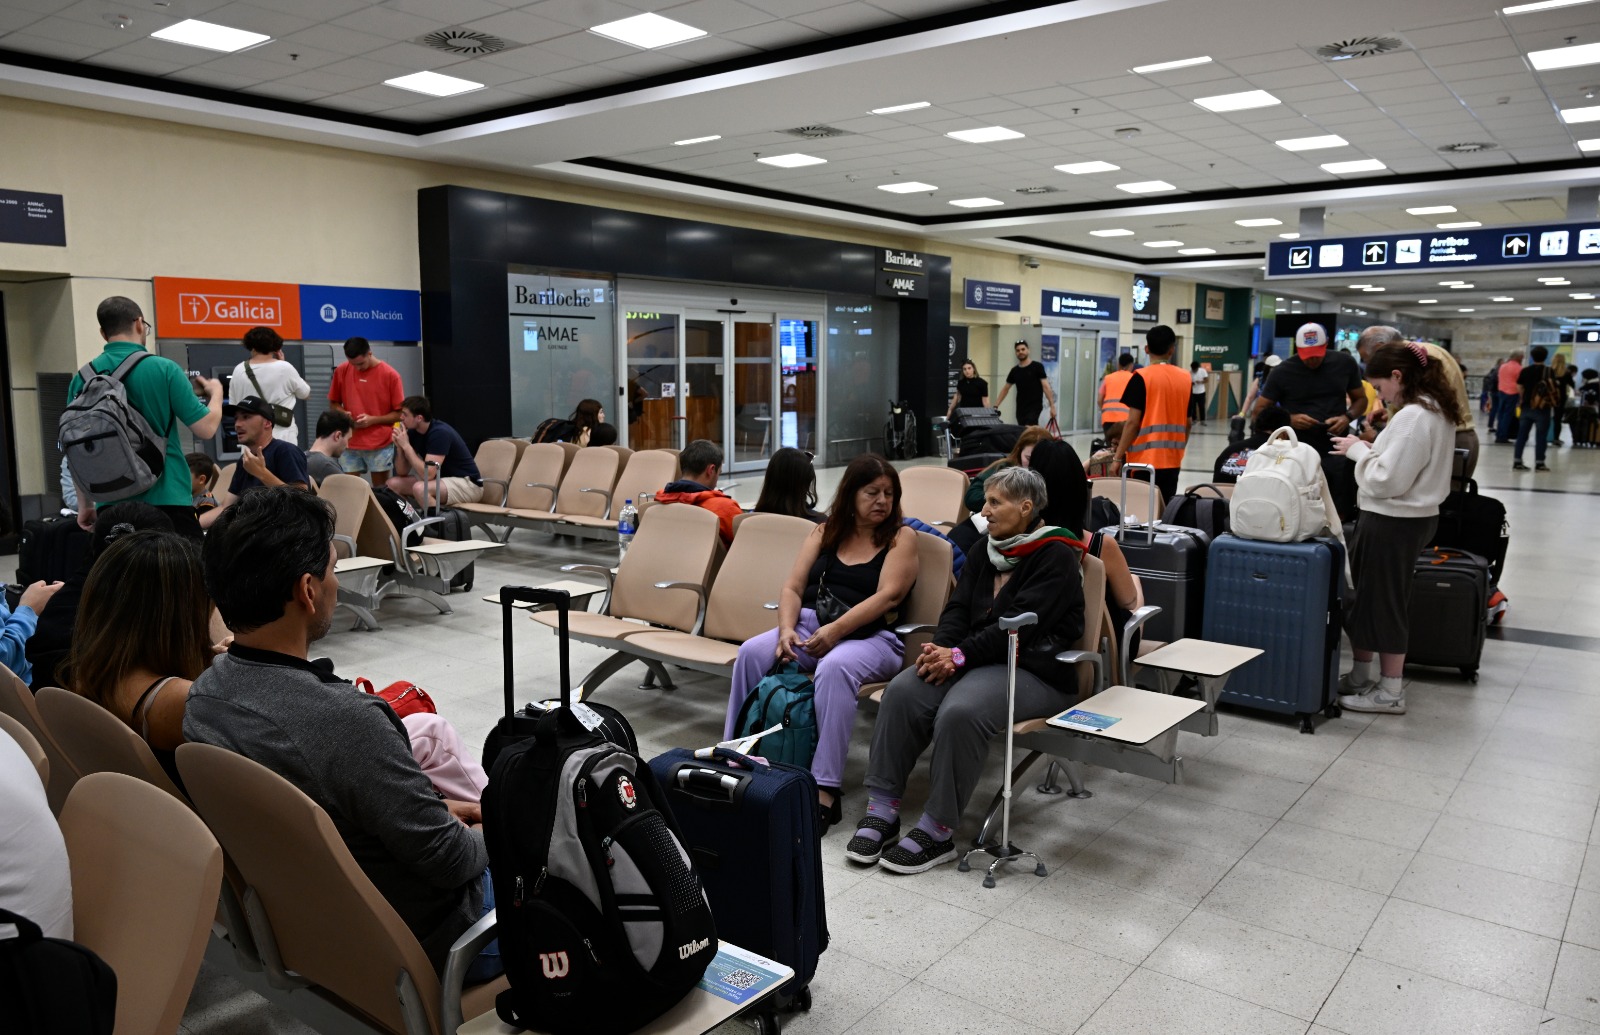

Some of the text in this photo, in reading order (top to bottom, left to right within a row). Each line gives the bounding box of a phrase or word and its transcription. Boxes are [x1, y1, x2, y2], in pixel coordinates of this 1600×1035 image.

[1430, 236, 1469, 247] Arribos
[885, 249, 923, 268] Bariloche
[892, 278, 915, 291] AMAE
[515, 285, 591, 308] Bariloche
[214, 301, 275, 320] Galicia
[341, 310, 404, 320] Banco Nación
[537, 326, 579, 342] AMAE
[678, 937, 709, 960] Wilson
